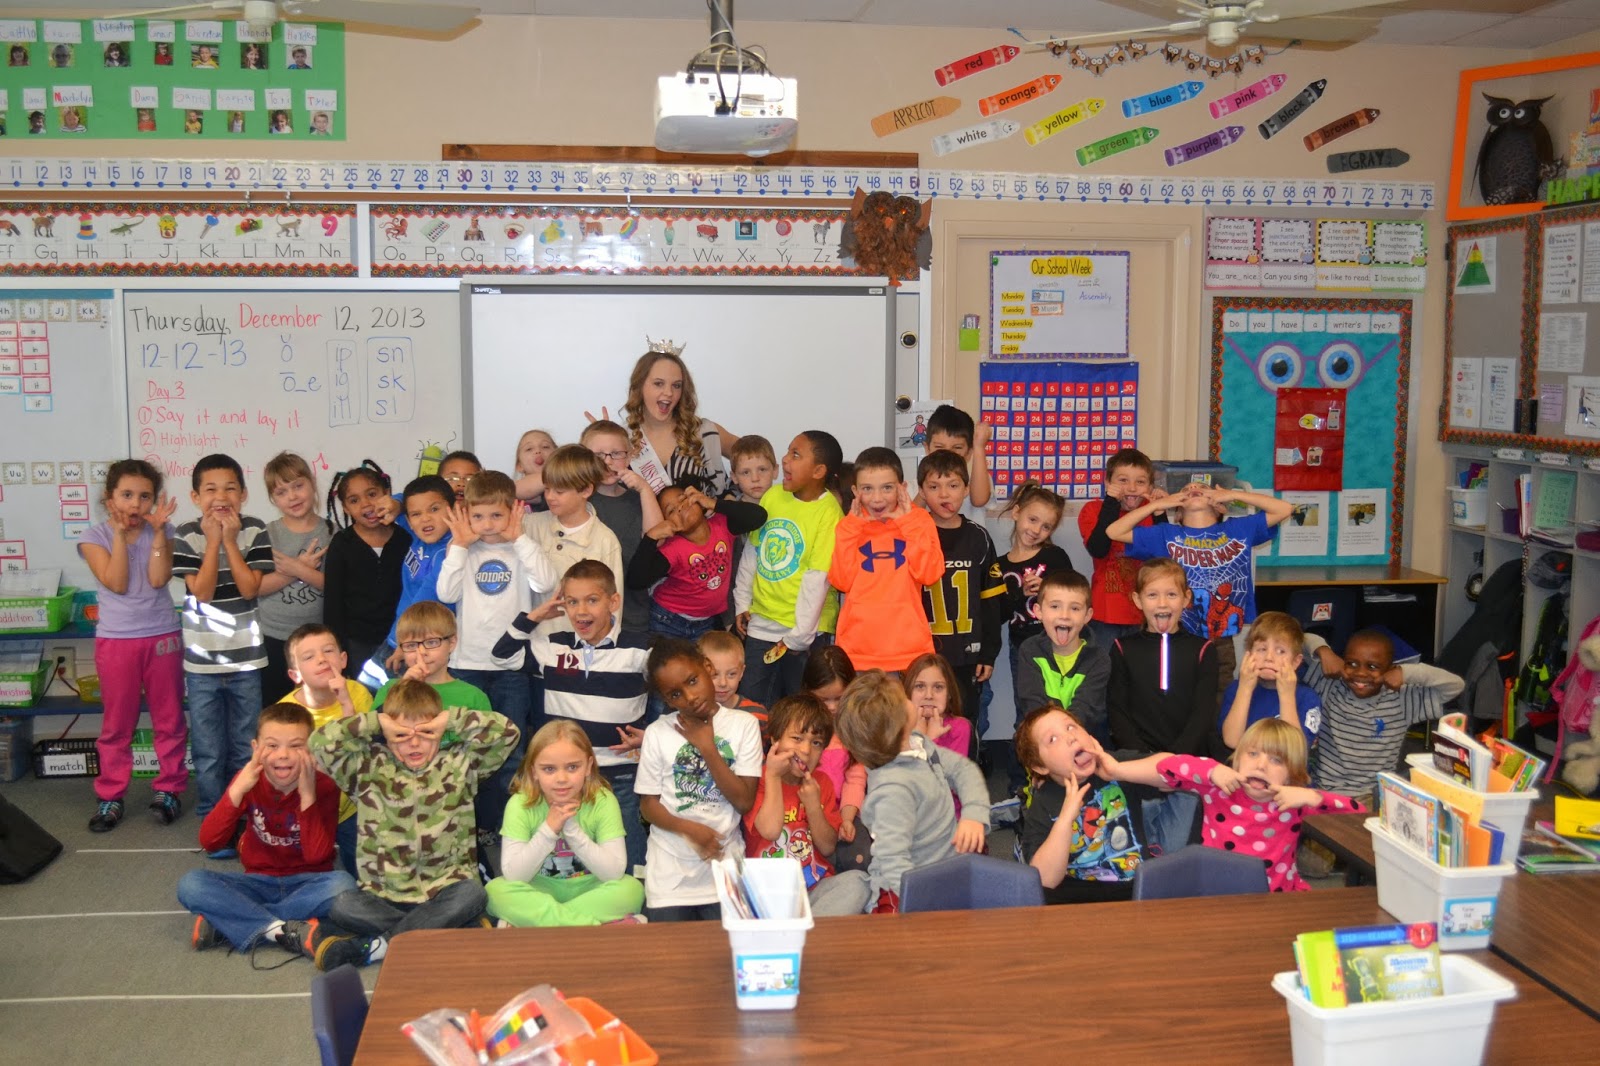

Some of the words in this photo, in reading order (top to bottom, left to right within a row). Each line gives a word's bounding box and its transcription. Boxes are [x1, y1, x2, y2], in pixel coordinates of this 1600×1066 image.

[964, 56, 984, 71] red
[999, 85, 1037, 106] orange
[1149, 93, 1172, 108] blue
[1234, 89, 1257, 108] pink
[893, 99, 937, 130] APRICOT
[1278, 98, 1305, 124] black
[1045, 109, 1079, 136] yellow
[1322, 117, 1356, 139] brown
[956, 128, 988, 145] white
[1099, 134, 1130, 156] green
[1185, 135, 1219, 159] purple
[11, 165, 22, 179] 11
[35, 166, 49, 180] 12
[59, 166, 73, 180] 13
[84, 166, 96, 180] 14
[108, 166, 121, 180] 15
[132, 166, 145, 180] 16
[457, 169, 473, 183] 30
[481, 169, 493, 183] 31
[504, 170, 519, 183] 32
[527, 170, 542, 183] 33
[551, 170, 565, 184] 34
[755, 174, 770, 187] 43
[777, 175, 792, 188] 44
[800, 175, 814, 188] 45
[822, 175, 837, 188] 46
[1035, 180, 1049, 193] 56
[1056, 181, 1070, 194] 57
[1077, 182, 1091, 194] 58
[1098, 182, 1112, 195] 59
[1119, 182, 1133, 196] 60
[34, 243, 59, 265] Gg
[76, 244, 99, 259] Hh
[123, 243, 133, 259] Ii
[159, 243, 179, 265] Jj
[200, 243, 220, 258] Kk
[243, 243, 257, 258] Ll
[275, 243, 305, 258] Mm
[319, 243, 341, 258] Nn
[383, 245, 407, 261] Oo
[425, 246, 444, 267] Pp
[460, 246, 484, 267] Qq
[504, 247, 521, 262] Rr
[544, 247, 562, 262] Ss
[661, 248, 679, 262] Vv
[692, 248, 724, 262] Ww
[737, 248, 757, 262] Xx
[776, 248, 793, 266] Yy
[813, 248, 831, 263] Zz
[1031, 259, 1045, 275] Our
[1046, 259, 1069, 275] School
[1069, 258, 1092, 275] Week
[1264, 272, 1277, 280] Can
[1279, 274, 1292, 283] you
[1380, 274, 1396, 282] love
[1001, 292, 1025, 301] Monday
[239, 303, 323, 329] December
[334, 305, 360, 332] 12,
[371, 306, 426, 329] 2013
[1002, 306, 1025, 315] Tuesday
[1000, 319, 1033, 328] Wednesday
[1229, 319, 1240, 329] Do
[1252, 320, 1266, 332] you
[1280, 320, 1298, 329] have
[1332, 320, 1362, 329] writer's
[1001, 333, 1026, 341] Thursday
[141, 338, 248, 370] 12-12-13
[376, 346, 404, 364] sn
[1001, 345, 1020, 353] Friday
[378, 367, 406, 391] sk
[147, 380, 171, 403] Day
[175, 380, 185, 398] 3
[156, 406, 185, 431] Say
[197, 408, 211, 425] it
[220, 409, 247, 425] and
[258, 410, 277, 435] lay
[160, 433, 220, 456] Highlight
[235, 434, 249, 447] it
[1184, 532, 1229, 549] AMAZING
[475, 571, 513, 584] ADIDAS
[556, 653, 580, 676] 12
[50, 760, 85, 772] match
